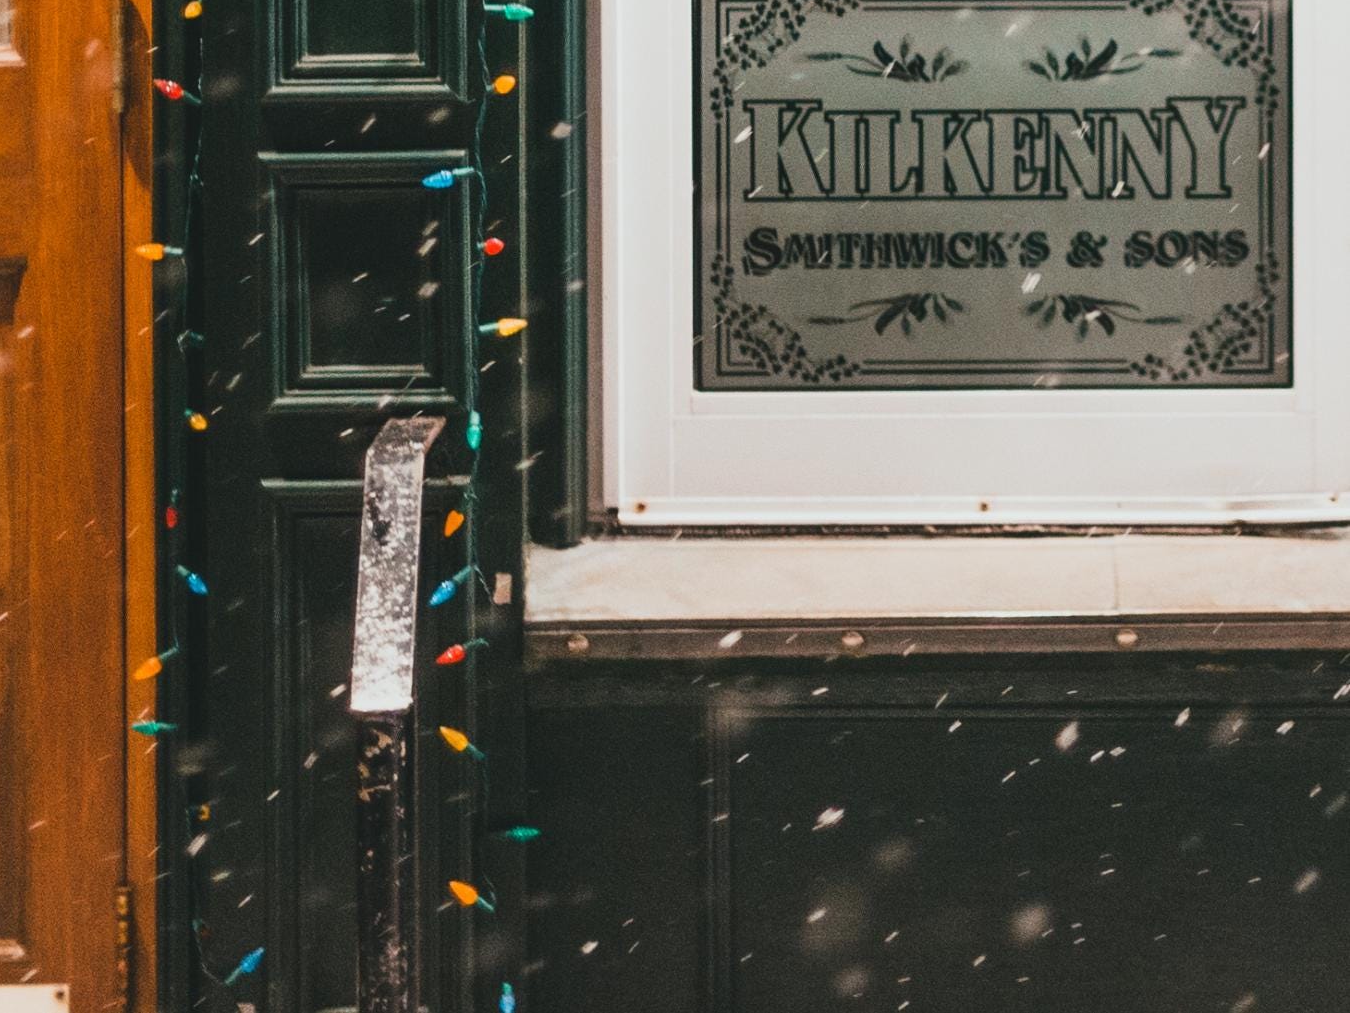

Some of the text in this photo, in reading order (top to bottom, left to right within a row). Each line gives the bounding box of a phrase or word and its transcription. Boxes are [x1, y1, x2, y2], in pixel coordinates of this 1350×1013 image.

[743, 96, 1246, 202] KILKENNY
[743, 227, 1250, 276] SMITHWICK'S & SONS
